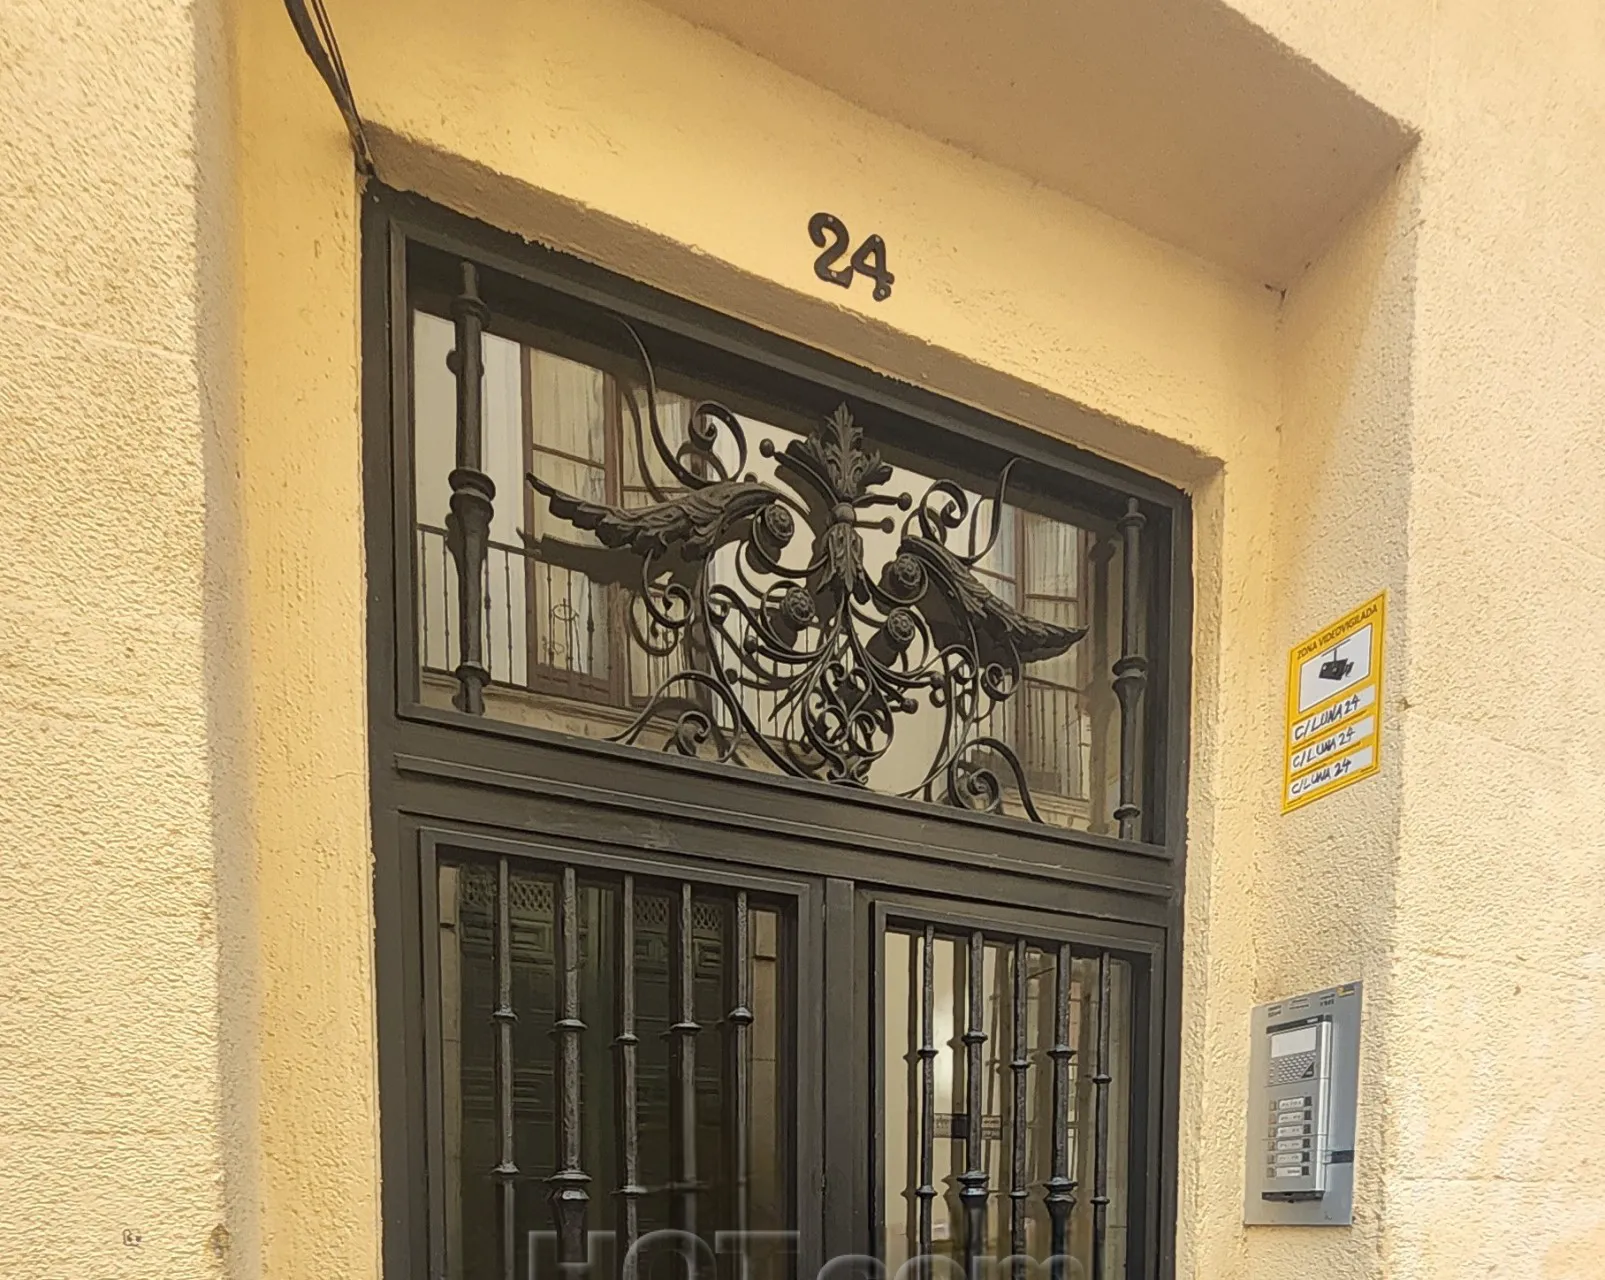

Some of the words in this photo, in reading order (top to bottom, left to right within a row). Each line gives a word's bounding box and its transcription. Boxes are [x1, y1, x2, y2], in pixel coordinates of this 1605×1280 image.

[807, 212, 895, 302] 24
[1297, 641, 1318, 660] ZONA
[1319, 604, 1377, 646] VIDEOVIGILADA
[1344, 694, 1361, 714] 24
[1338, 726, 1356, 746] 24
[1334, 757, 1352, 777] 24
